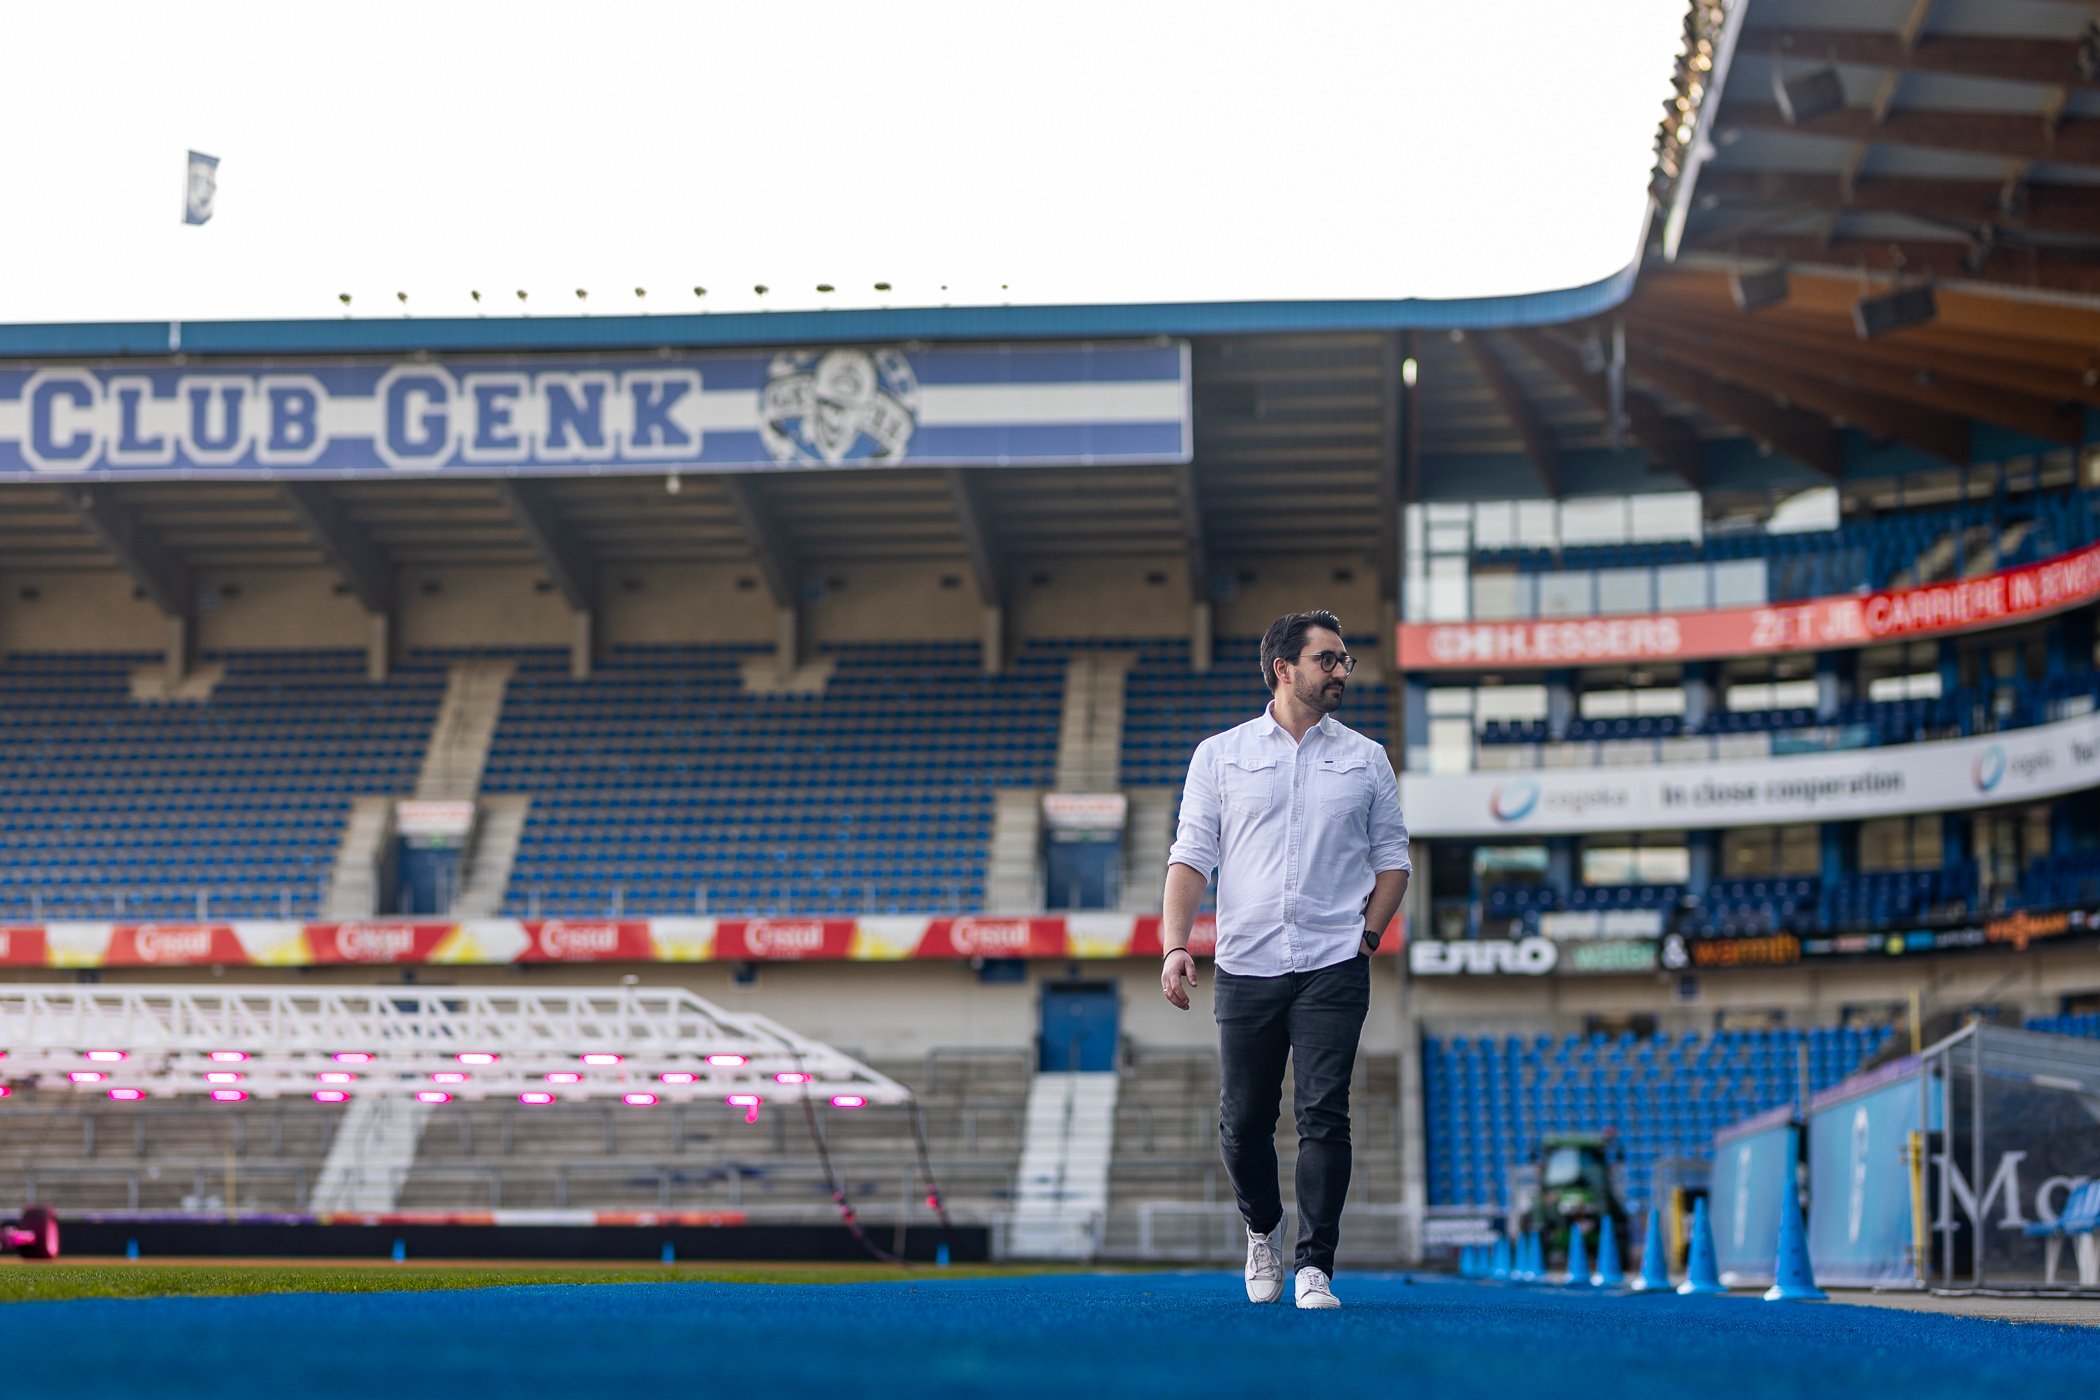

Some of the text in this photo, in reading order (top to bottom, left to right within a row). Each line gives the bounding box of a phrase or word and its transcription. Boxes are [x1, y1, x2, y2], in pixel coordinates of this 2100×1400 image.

[21, 363, 702, 473] CLUB GENK
[1693, 776, 1758, 804] close
[1765, 767, 1905, 805] cooperation
[1662, 932, 1690, 970] &
